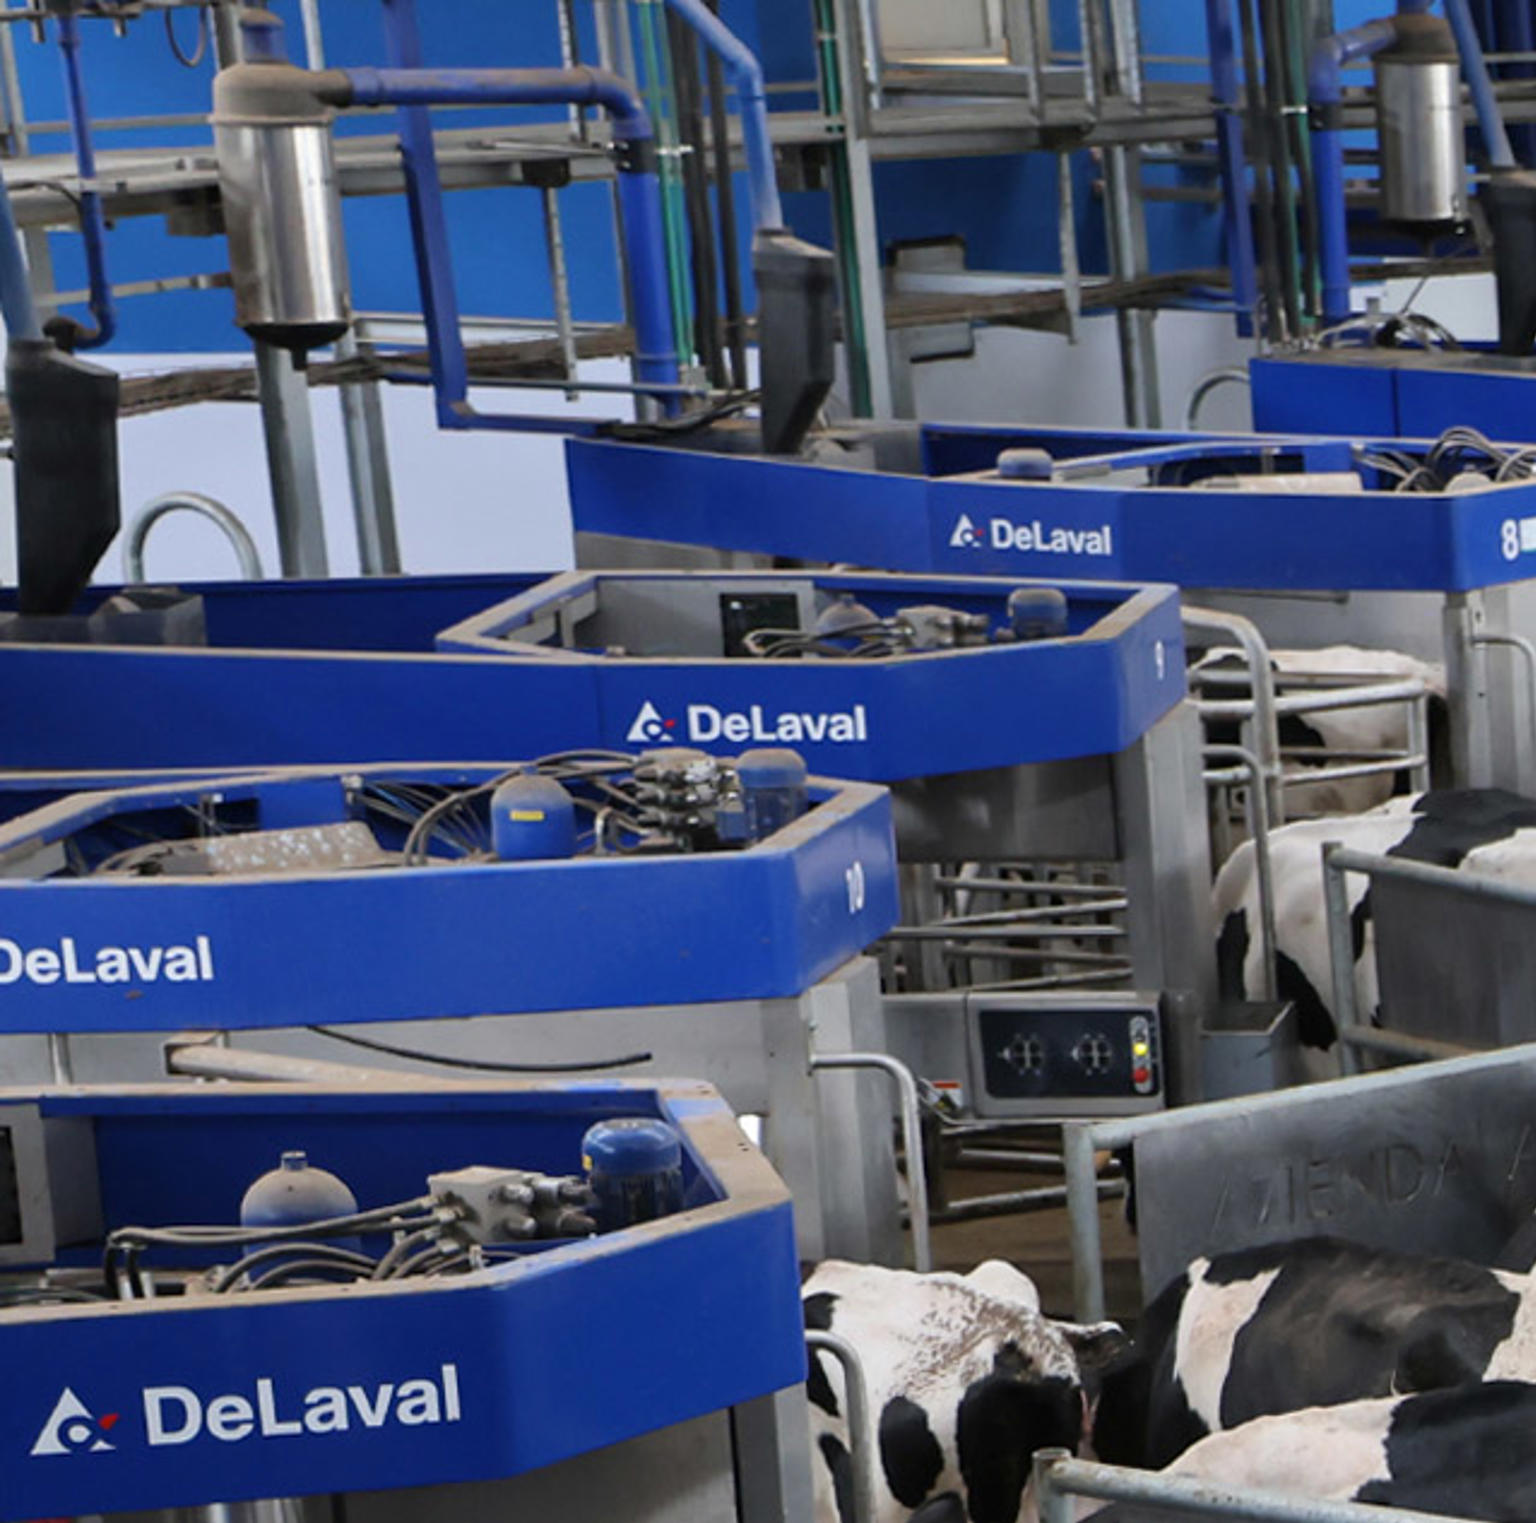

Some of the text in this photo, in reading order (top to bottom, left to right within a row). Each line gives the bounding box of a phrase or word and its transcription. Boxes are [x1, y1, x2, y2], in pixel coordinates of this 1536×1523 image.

[990, 518, 1112, 556] DeLaval
[1501, 519, 1520, 560] 8
[1154, 640, 1165, 680] 9
[687, 705, 867, 742] DeLaval
[845, 860, 865, 914] 10
[144, 1364, 461, 1446] DeLaval
